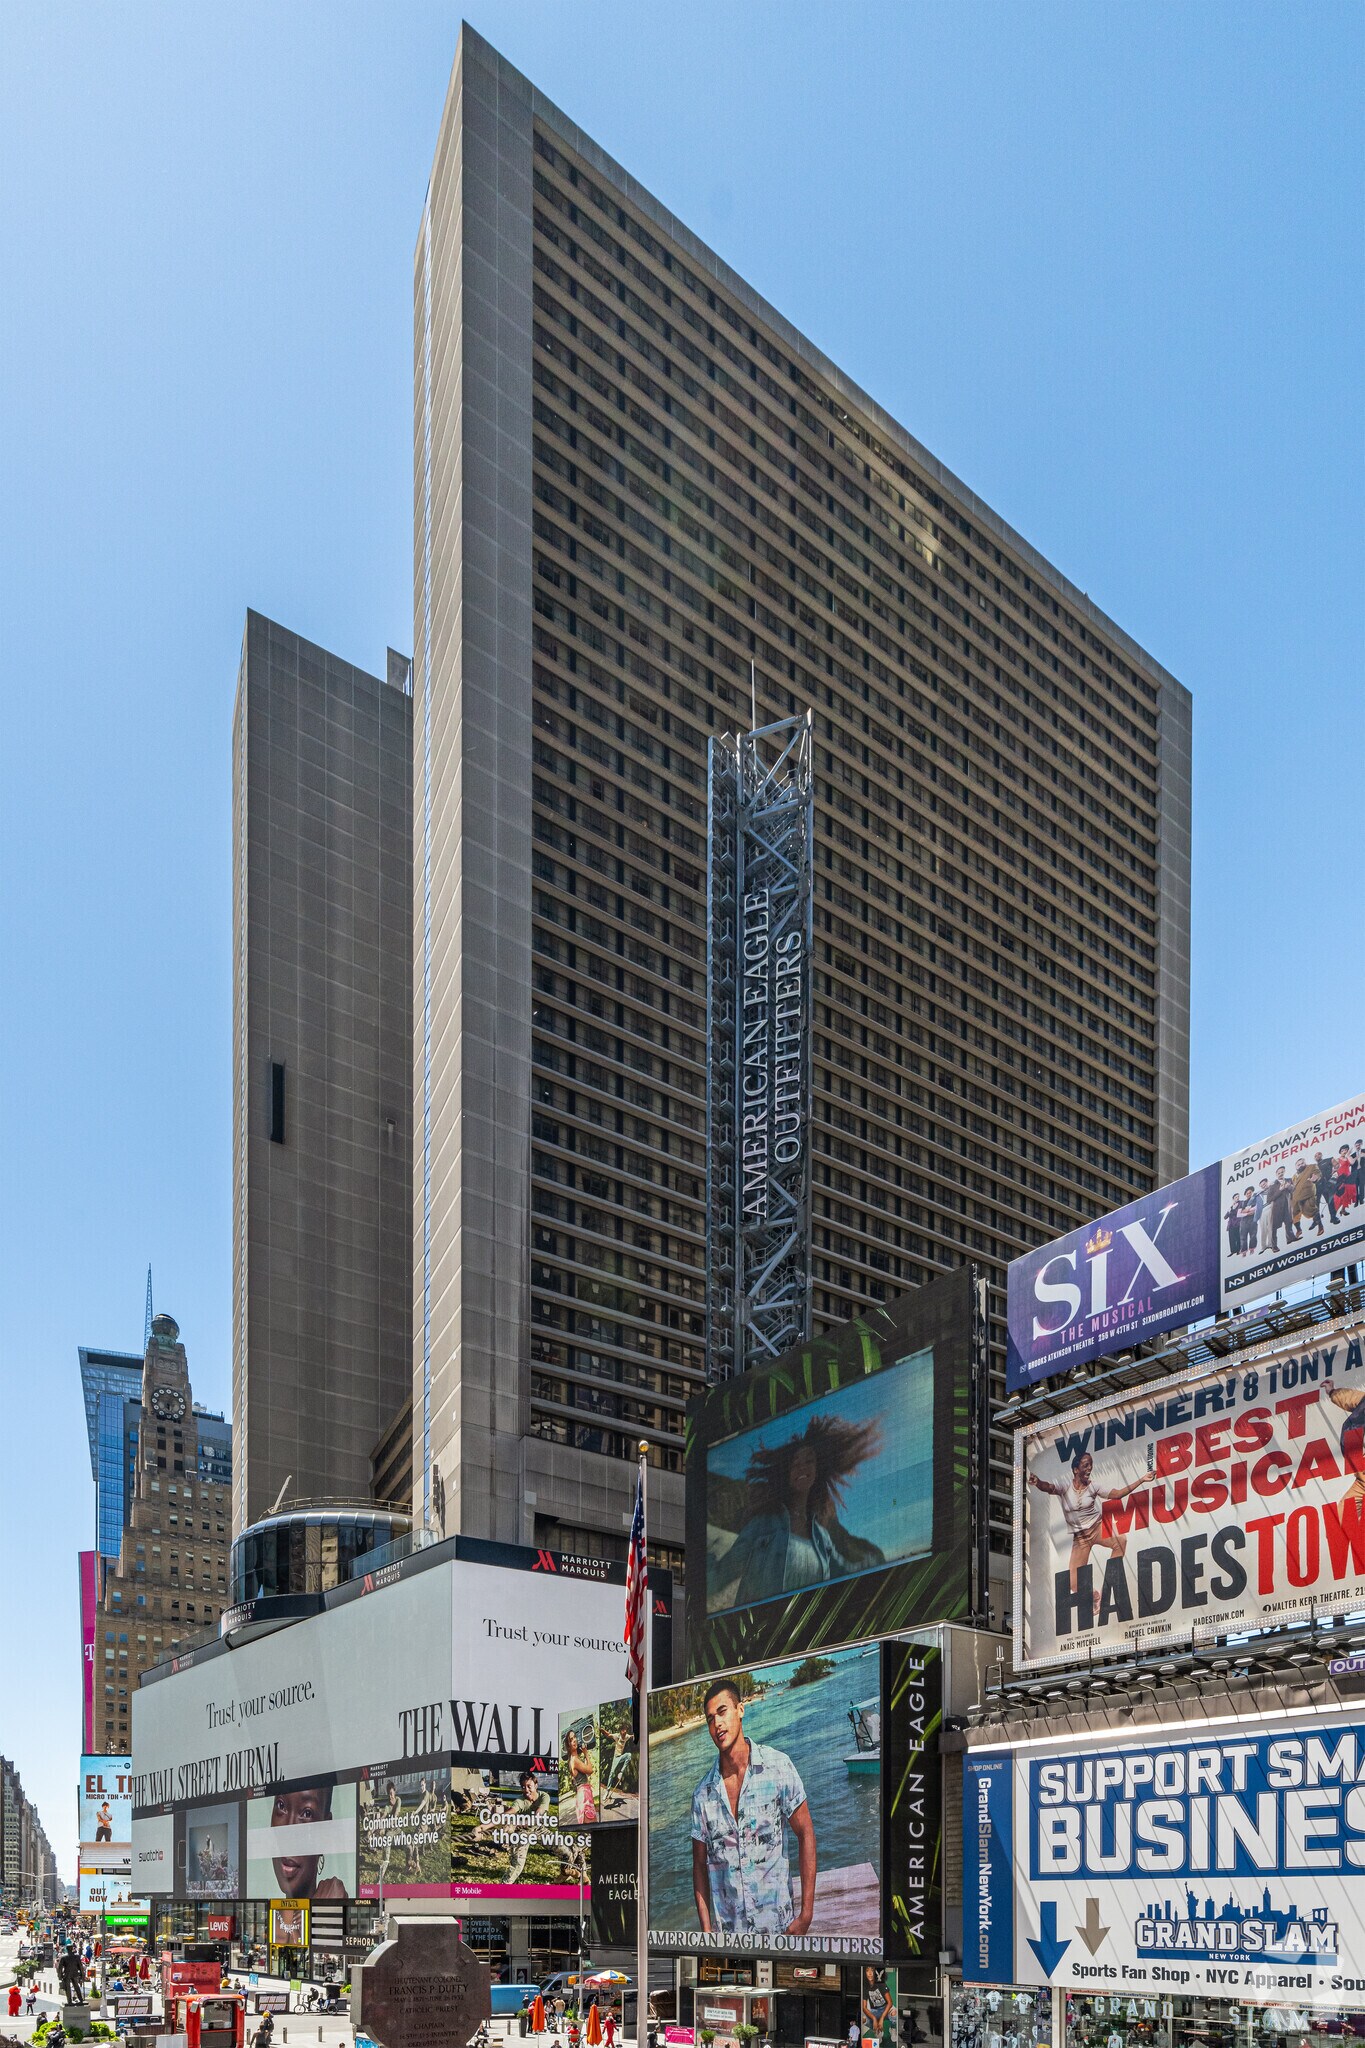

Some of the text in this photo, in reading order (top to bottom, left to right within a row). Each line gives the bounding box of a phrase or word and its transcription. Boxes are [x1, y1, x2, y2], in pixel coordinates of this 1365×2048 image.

[742, 888, 769, 1219] AMERICAN EAGLE
[774, 930, 801, 1165] OUTFITTERS
[1233, 1123, 1321, 1173] BROADWAY'S
[1226, 1166, 1254, 1185] AND
[1249, 1230, 1365, 1281] NEW WORLD STAGES
[1032, 1202, 1186, 1341] SIX
[1060, 1325, 1084, 1344] THE
[1091, 1297, 1153, 1332] MUSICAL
[1028, 1355, 1047, 1370] BROOKS
[1047, 1346, 1072, 1364] ATKINSON
[1072, 1336, 1095, 1352] THEATRE
[1109, 1329, 1116, 1339] W
[1116, 1324, 1130, 1336] 47TH
[1130, 1320, 1139, 1332] ST
[1142, 1294, 1205, 1326] SIXONBROADWAY.COM
[1054, 1336, 1365, 1464] WINNER! 8 TONY A
[1155, 1389, 1321, 1479] BEST
[1101, 1427, 1365, 1540] MUSICAL
[375, 1561, 404, 1578] MARRIOTT
[561, 1554, 612, 1570] MARRIOTT
[561, 1564, 606, 1578] MARQUIS
[375, 1571, 401, 1587] MARQUIS
[228, 1601, 256, 1617] MARRIOTT
[1272, 1599, 1297, 1612] WALTER
[1299, 1595, 1318, 1607] KERR
[228, 1612, 252, 1624] MARQUIS
[1193, 1609, 1245, 1627] HADESTOWN.COM
[483, 1618, 627, 1654] Trust your source.
[1124, 1630, 1145, 1640] RACHEL
[1147, 1623, 1172, 1635] CHAVKIN
[1076, 1636, 1102, 1648] MITCHELL
[206, 1680, 316, 1730] Trust your source.
[398, 1699, 552, 1760] THE WALL
[148, 1768, 176, 1804] WALL
[178, 1756, 221, 1801] STREET
[223, 1742, 285, 1792] JOURNAL.
[370, 1763, 389, 1771] MARRIOTT
[982, 1763, 1003, 1771] ONLINE
[1038, 1743, 1261, 1806] SUPPORT
[86, 1775, 107, 1793] EL
[909, 1656, 925, 1940] AMERICAN EAGLE
[363, 1811, 447, 1831] Committed to serve
[369, 1831, 439, 1848] those who serve
[492, 1830, 538, 1846] those
[541, 1832, 574, 1848] who
[138, 1849, 159, 1863] swatch
[978, 1777, 992, 1969] GrandSlamNewYork.com
[89, 1895, 108, 1903] NOW
[90, 1887, 107, 1895] OUT
[461, 1886, 482, 1895] Mobile
[608, 1889, 639, 1900] EAGLE
[345, 1936, 375, 1946] SEPHORA
[647, 1930, 883, 1956] AMERICAN EAGLE OUTFITTERS
[1135, 1918, 1339, 1954] GRAND SLAM
[1229, 1953, 1251, 1961] YORK
[1072, 1962, 1117, 1979] Sports
[1121, 1965, 1147, 1980] Fan
[1152, 1967, 1190, 1985] Shop
[1206, 1969, 1239, 1985] NYC
[1244, 1971, 1313, 1989] Apparel
[389, 1985, 427, 1996] FRANCIS
[438, 1984, 469, 1994] DUFFY
[1094, 1996, 1175, 2020] GRAND
[1228, 2006, 1312, 2032] SLAM
